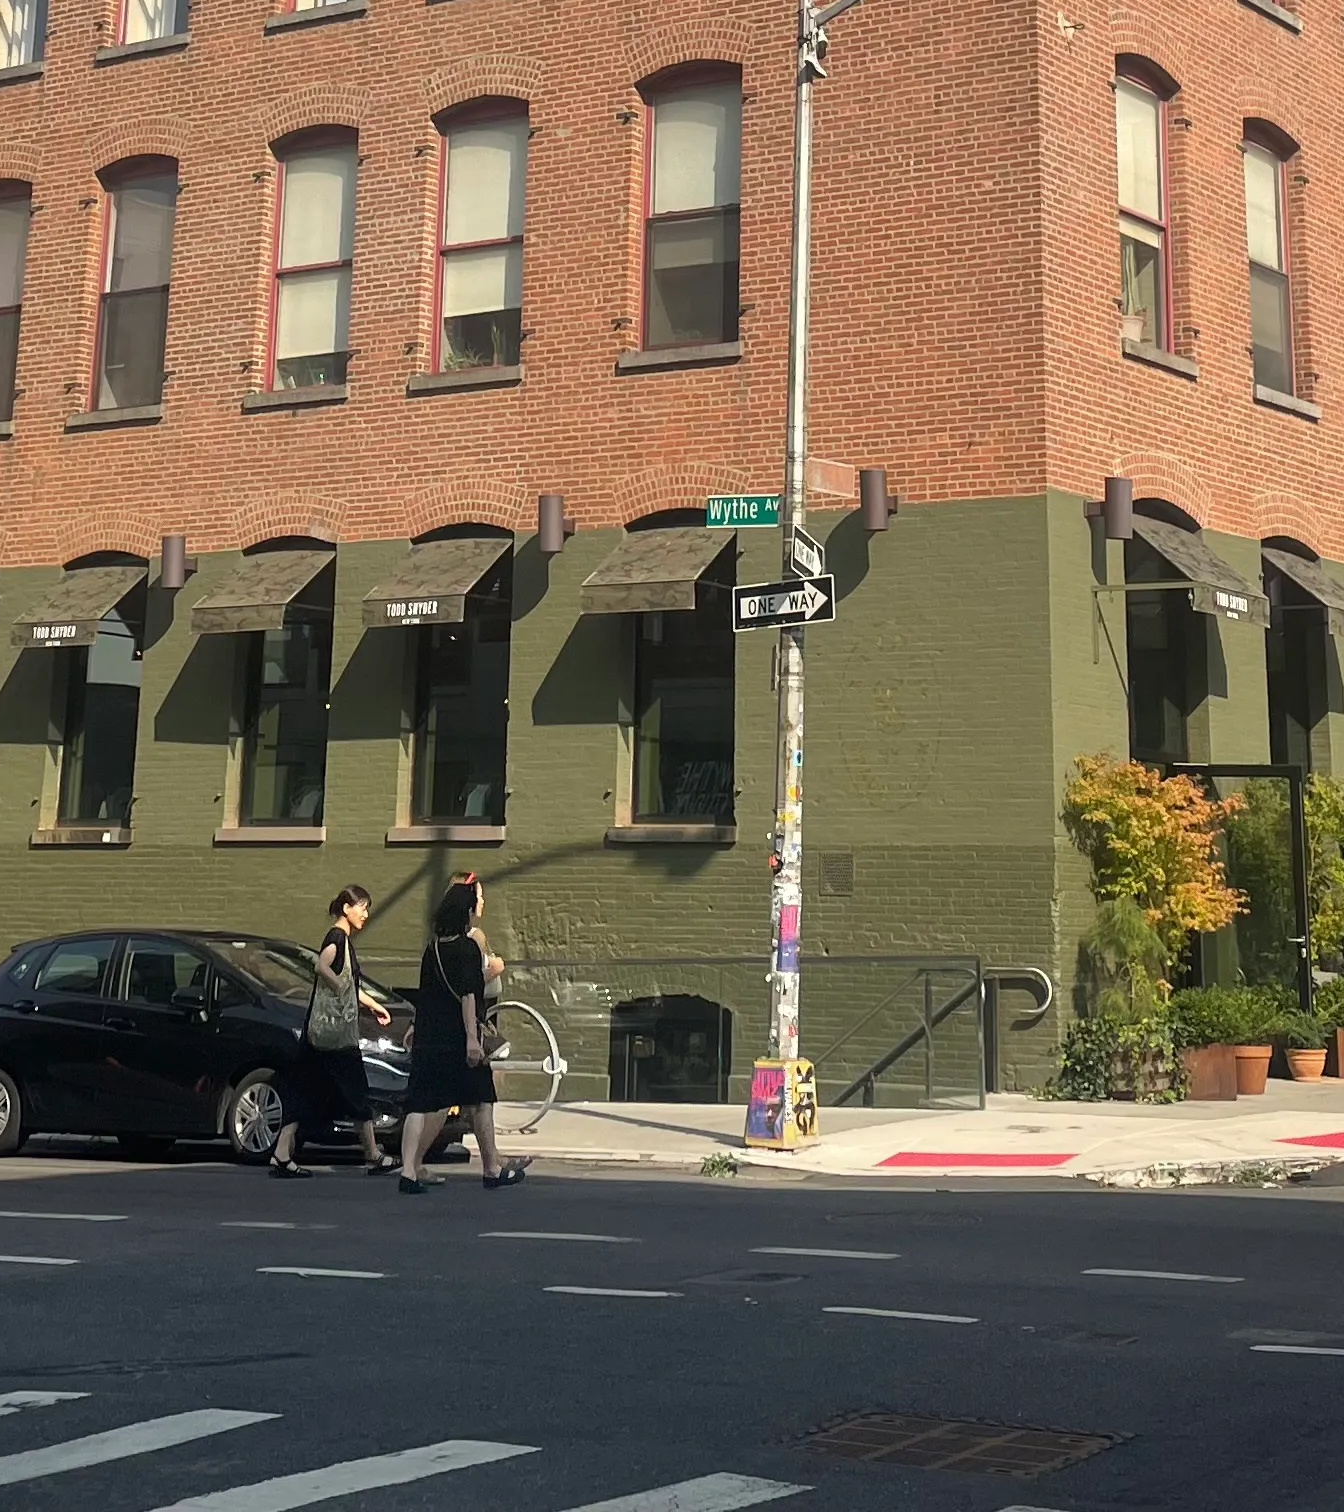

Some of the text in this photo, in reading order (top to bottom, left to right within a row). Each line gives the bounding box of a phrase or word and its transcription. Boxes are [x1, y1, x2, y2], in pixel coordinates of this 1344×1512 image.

[709, 498, 780, 525] Wythe Av
[796, 541, 805, 564] ONE
[386, 600, 438, 617] TODD SNYDER
[748, 592, 818, 616] ONE WAY
[33, 625, 77, 639] TODD SNYDER
